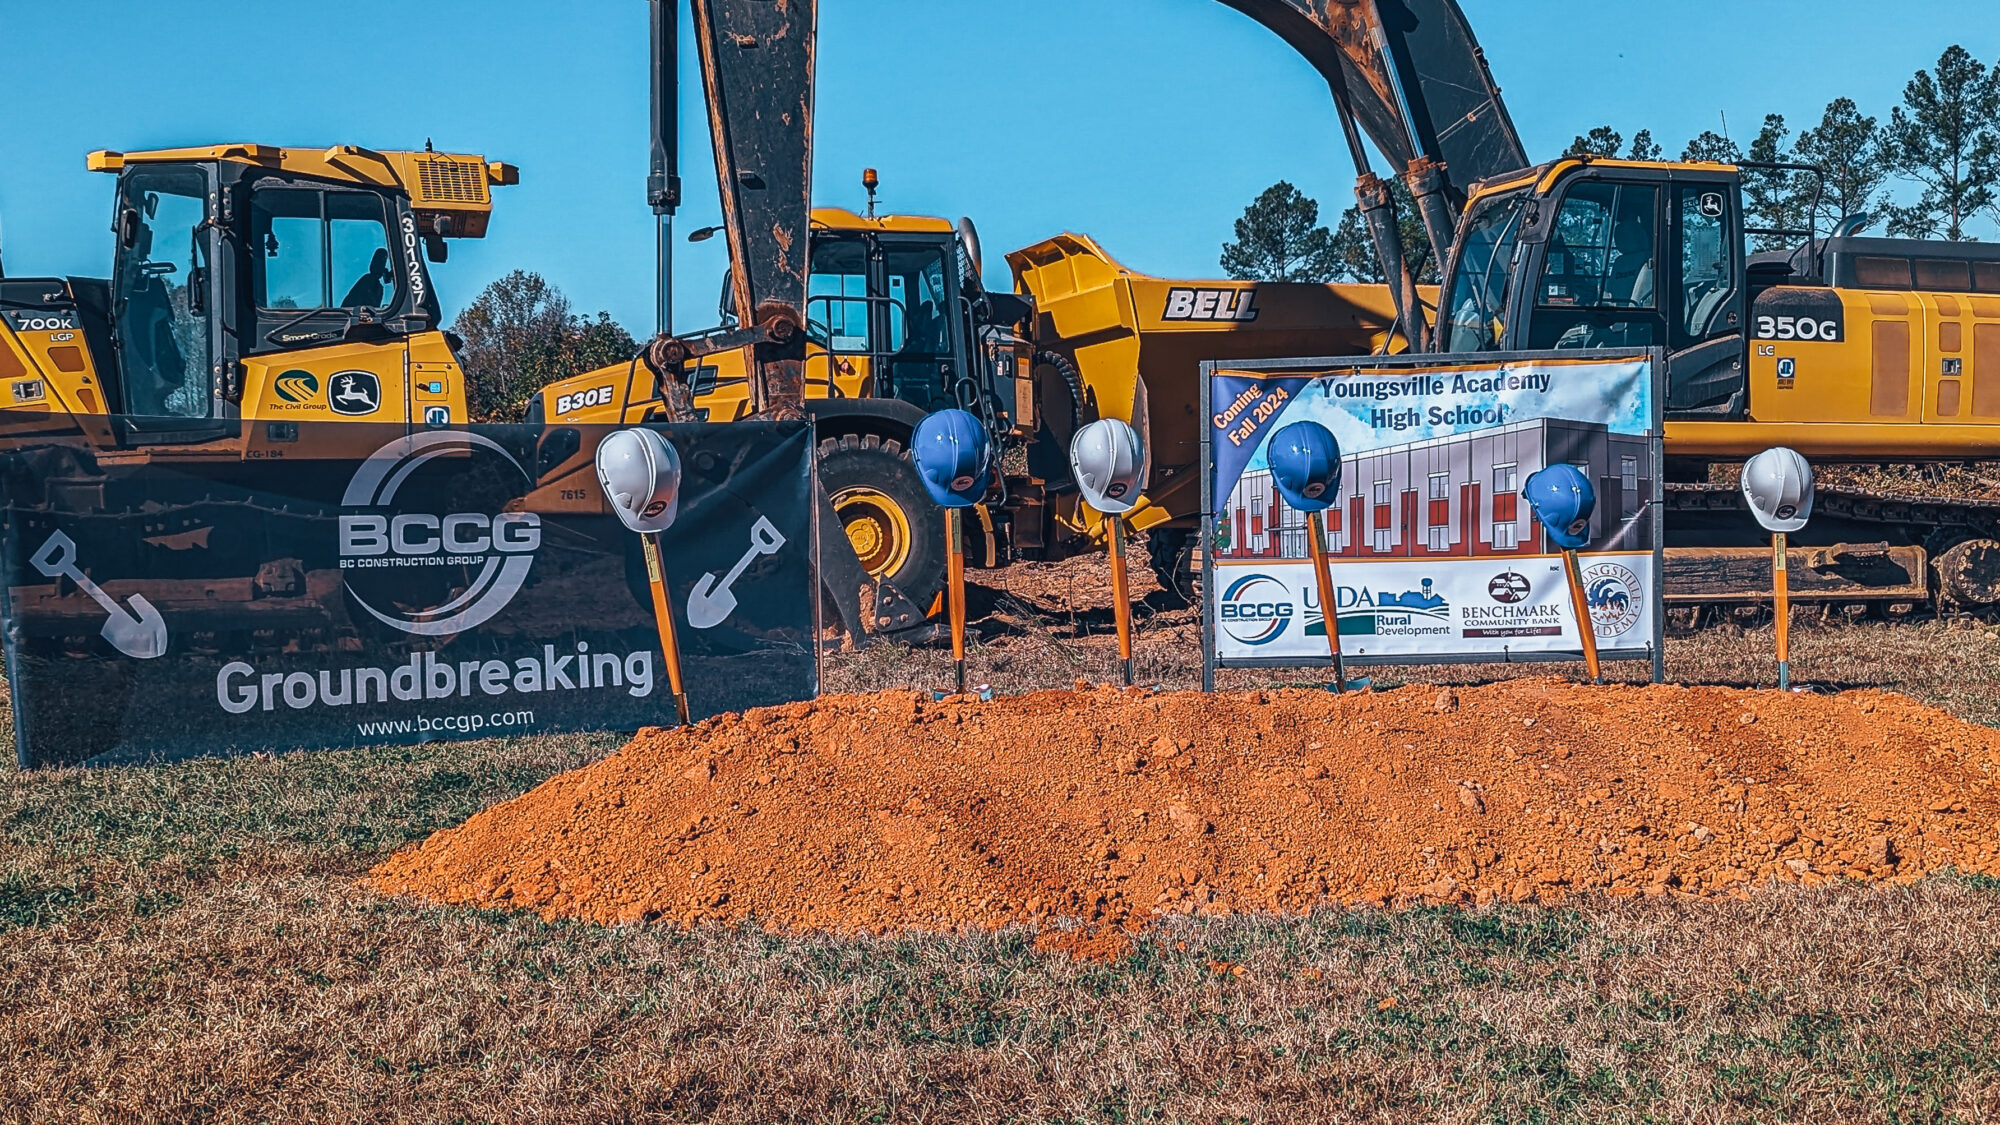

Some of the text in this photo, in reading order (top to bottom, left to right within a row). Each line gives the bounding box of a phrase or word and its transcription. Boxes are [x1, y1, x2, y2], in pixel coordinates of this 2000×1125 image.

[402, 217, 424, 305] 301237
[1164, 289, 1257, 320] BELL
[17, 318, 73, 330] 700K
[1757, 316, 1837, 340] 350G
[50, 333, 74, 341] LGP
[1758, 345, 1775, 355] LC
[1320, 372, 1551, 400] Youngsville Academy
[302, 402, 327, 411] Group
[556, 386, 614, 415] B30E
[1213, 383, 1263, 429] Coming
[1228, 386, 1289, 447] Fall 2024
[1370, 403, 1503, 431] High School
[560, 489, 586, 500] 7615
[339, 512, 541, 556] BCCG
[339, 556, 484, 568] BC CONSTRUCTION GROUP
[1582, 564, 1641, 602] UNGSVILLE
[1303, 586, 1375, 608] UDA
[1221, 603, 1294, 618] BCCG
[1376, 614, 1412, 626] Rural
[1462, 604, 1560, 618] BENCHMARK
[1464, 618, 1529, 626] COMMUNITY
[1594, 609, 1638, 636] ADEMY
[1376, 625, 1451, 637] Development
[217, 641, 654, 714] Groundbreaking
[357, 708, 534, 736] www.bccgp.com
